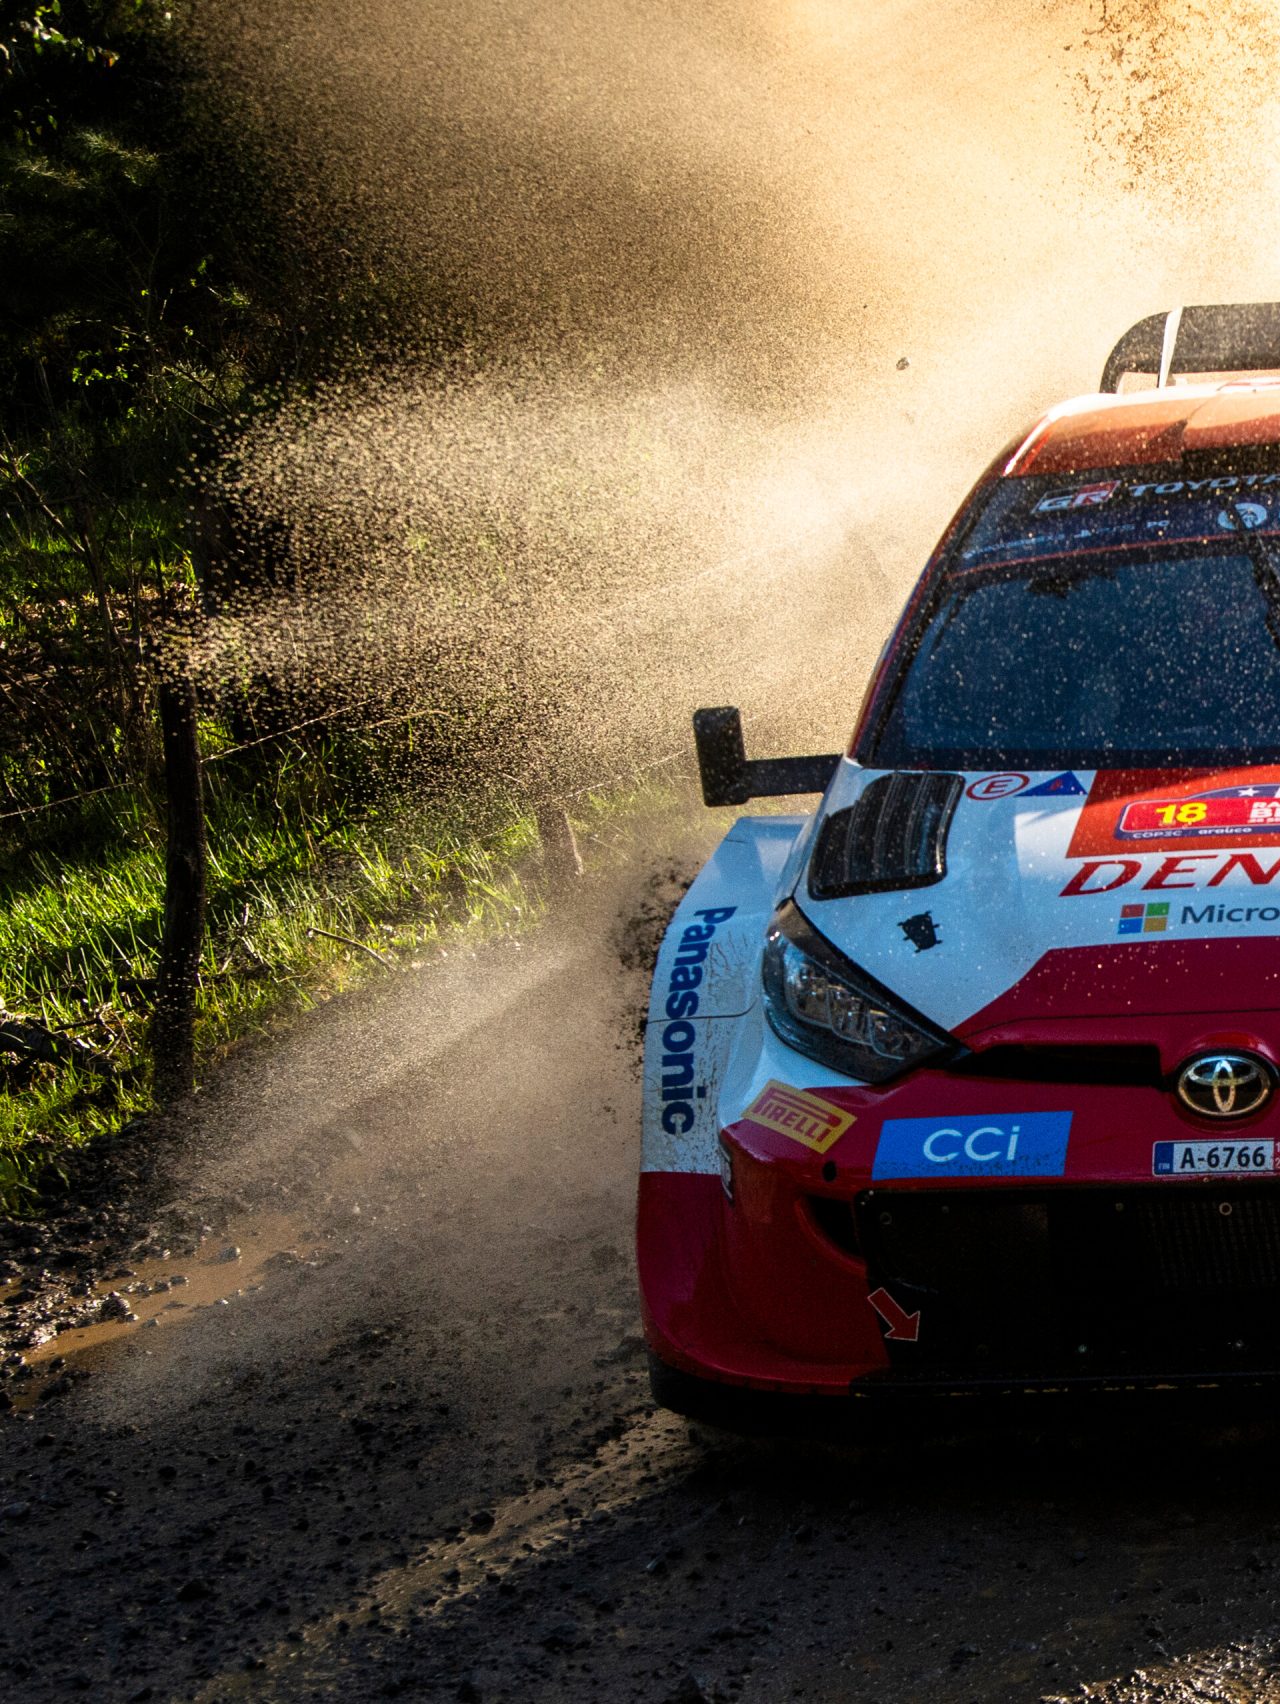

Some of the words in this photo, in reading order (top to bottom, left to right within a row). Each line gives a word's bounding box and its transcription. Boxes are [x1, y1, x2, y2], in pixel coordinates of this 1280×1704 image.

[983, 779, 1013, 794] E
[1156, 802, 1207, 824] 18
[662, 906, 737, 1135] Panasonic
[753, 1087, 841, 1143] PIRELLI
[922, 1126, 1021, 1162] CCi
[1180, 1146, 1266, 1169] A-6766
